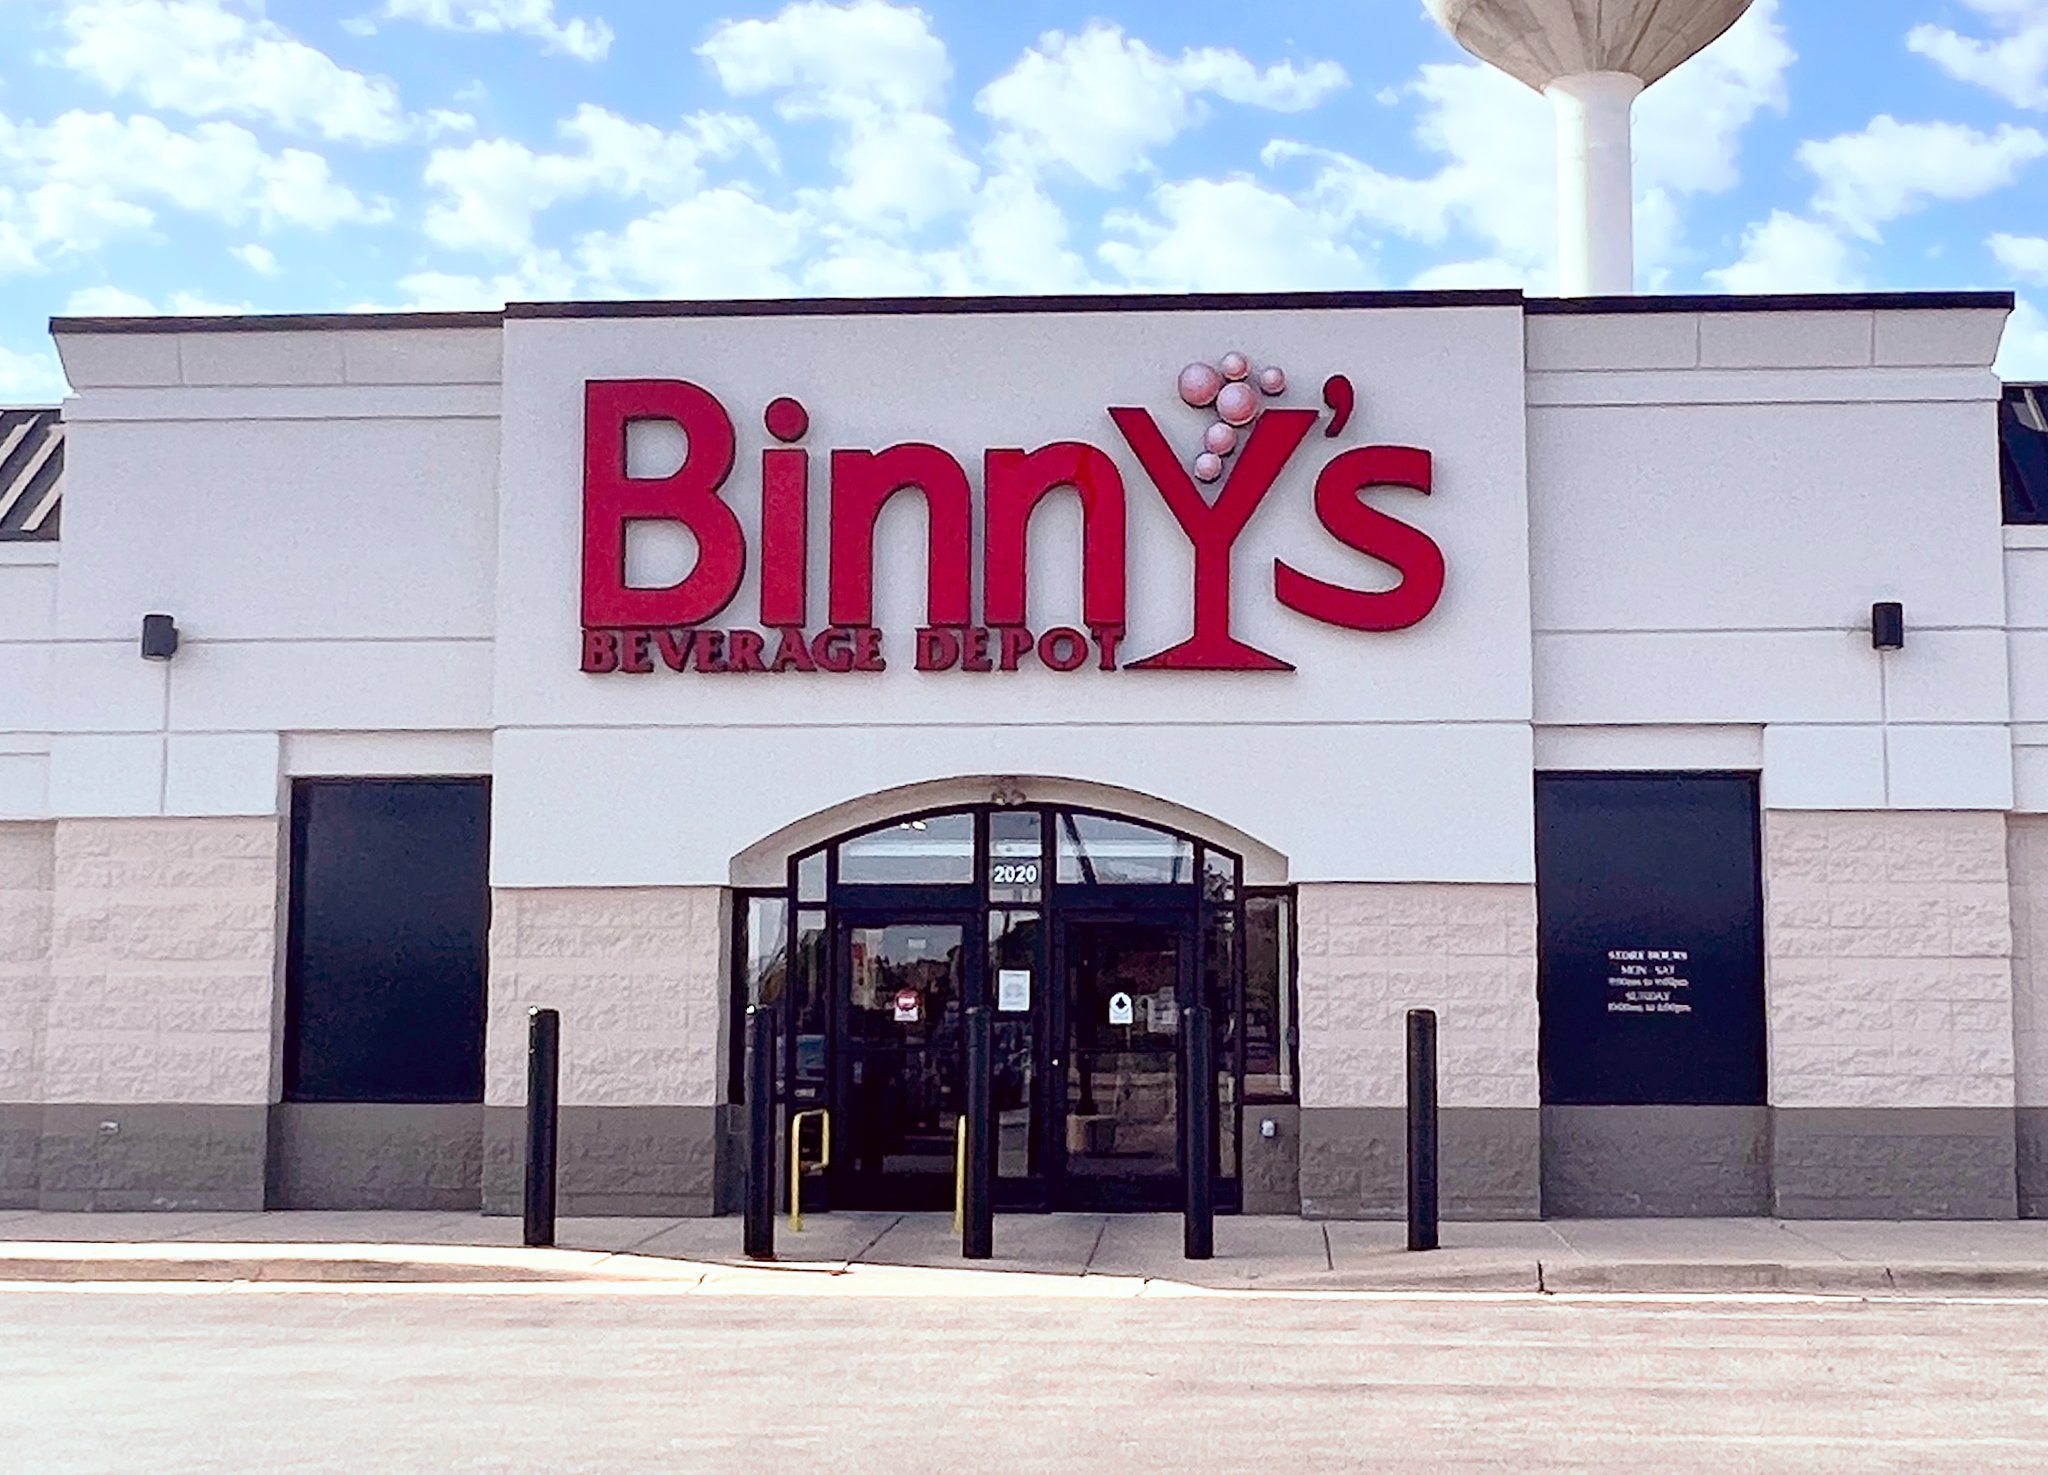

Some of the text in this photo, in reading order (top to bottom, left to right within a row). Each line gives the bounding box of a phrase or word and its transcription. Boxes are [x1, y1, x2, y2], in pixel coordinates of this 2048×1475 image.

[580, 626, 1125, 673] BEVERAGE DEPOT
[993, 864, 1038, 883] 2020
[1608, 950, 1645, 961] STORE
[1620, 964, 1675, 975] MON SAT
[1624, 991, 1671, 1001] SUNDAY
